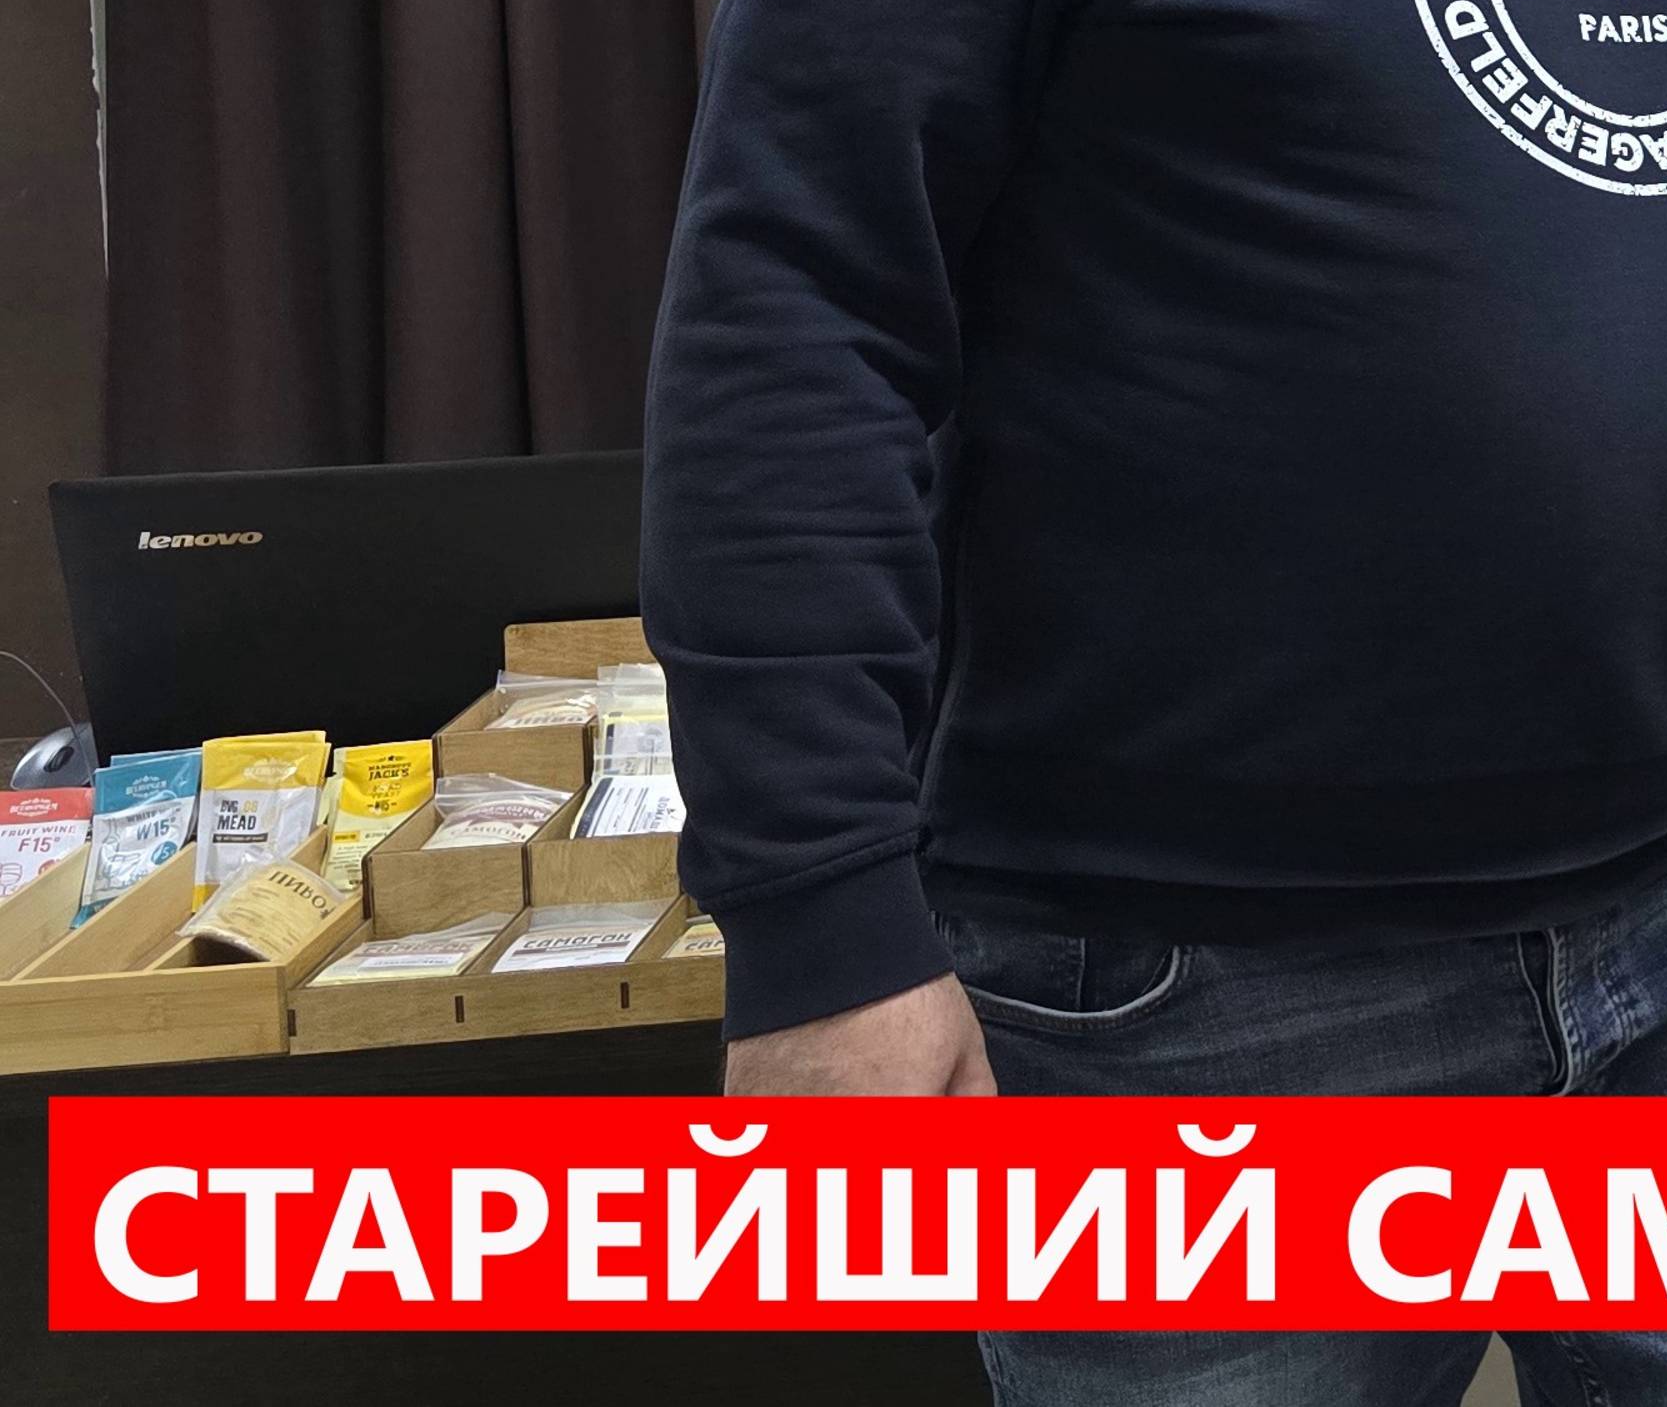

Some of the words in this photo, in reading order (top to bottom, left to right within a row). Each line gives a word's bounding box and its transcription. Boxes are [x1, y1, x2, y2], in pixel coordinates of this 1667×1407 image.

[138, 531, 263, 550] lenovo
[217, 814, 257, 831] MEAD
[522, 932, 633, 950] САМОГОН
